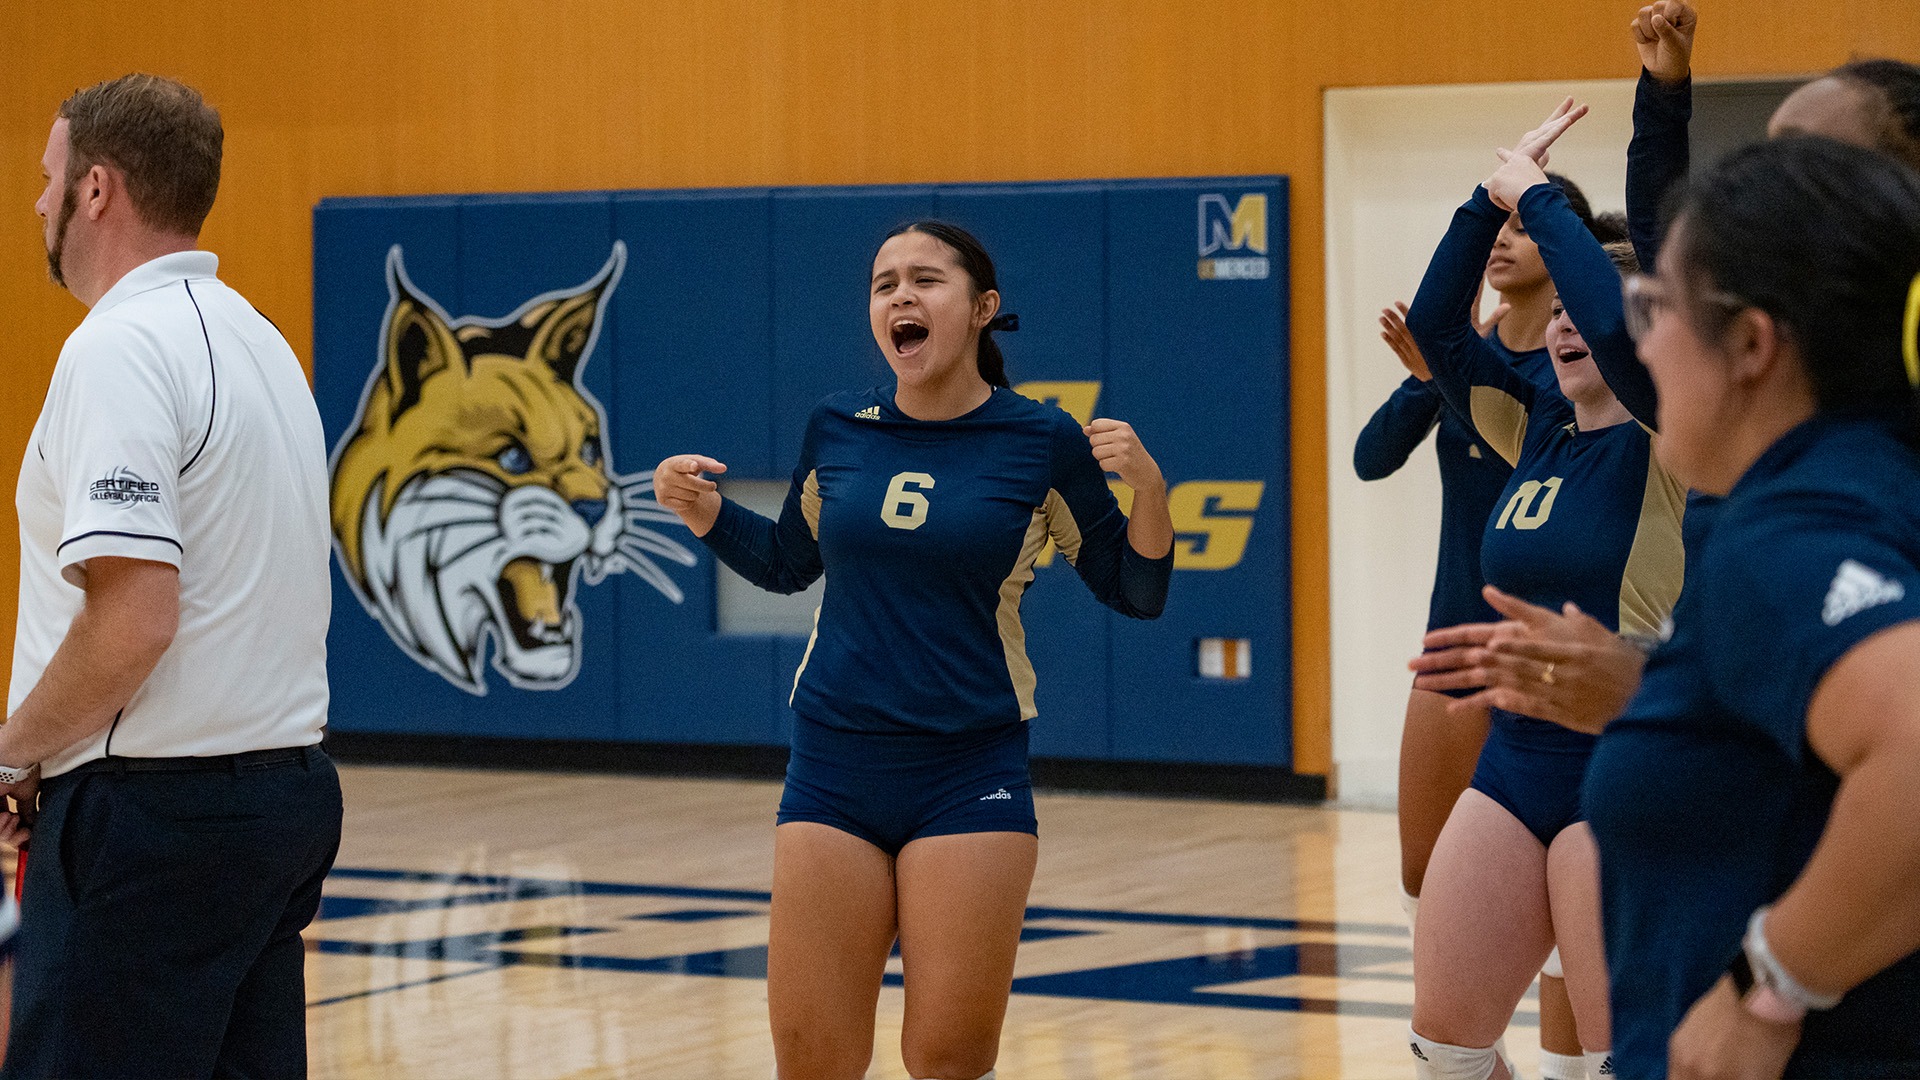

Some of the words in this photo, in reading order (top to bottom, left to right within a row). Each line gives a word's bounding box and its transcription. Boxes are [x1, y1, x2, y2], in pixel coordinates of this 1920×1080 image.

[855, 411, 880, 420] adidas
[89, 479, 159, 491] CERTIFIED
[131, 493, 160, 503] OFFICIAL
[881, 471, 935, 530] 6
[1495, 476, 1564, 530] 10
